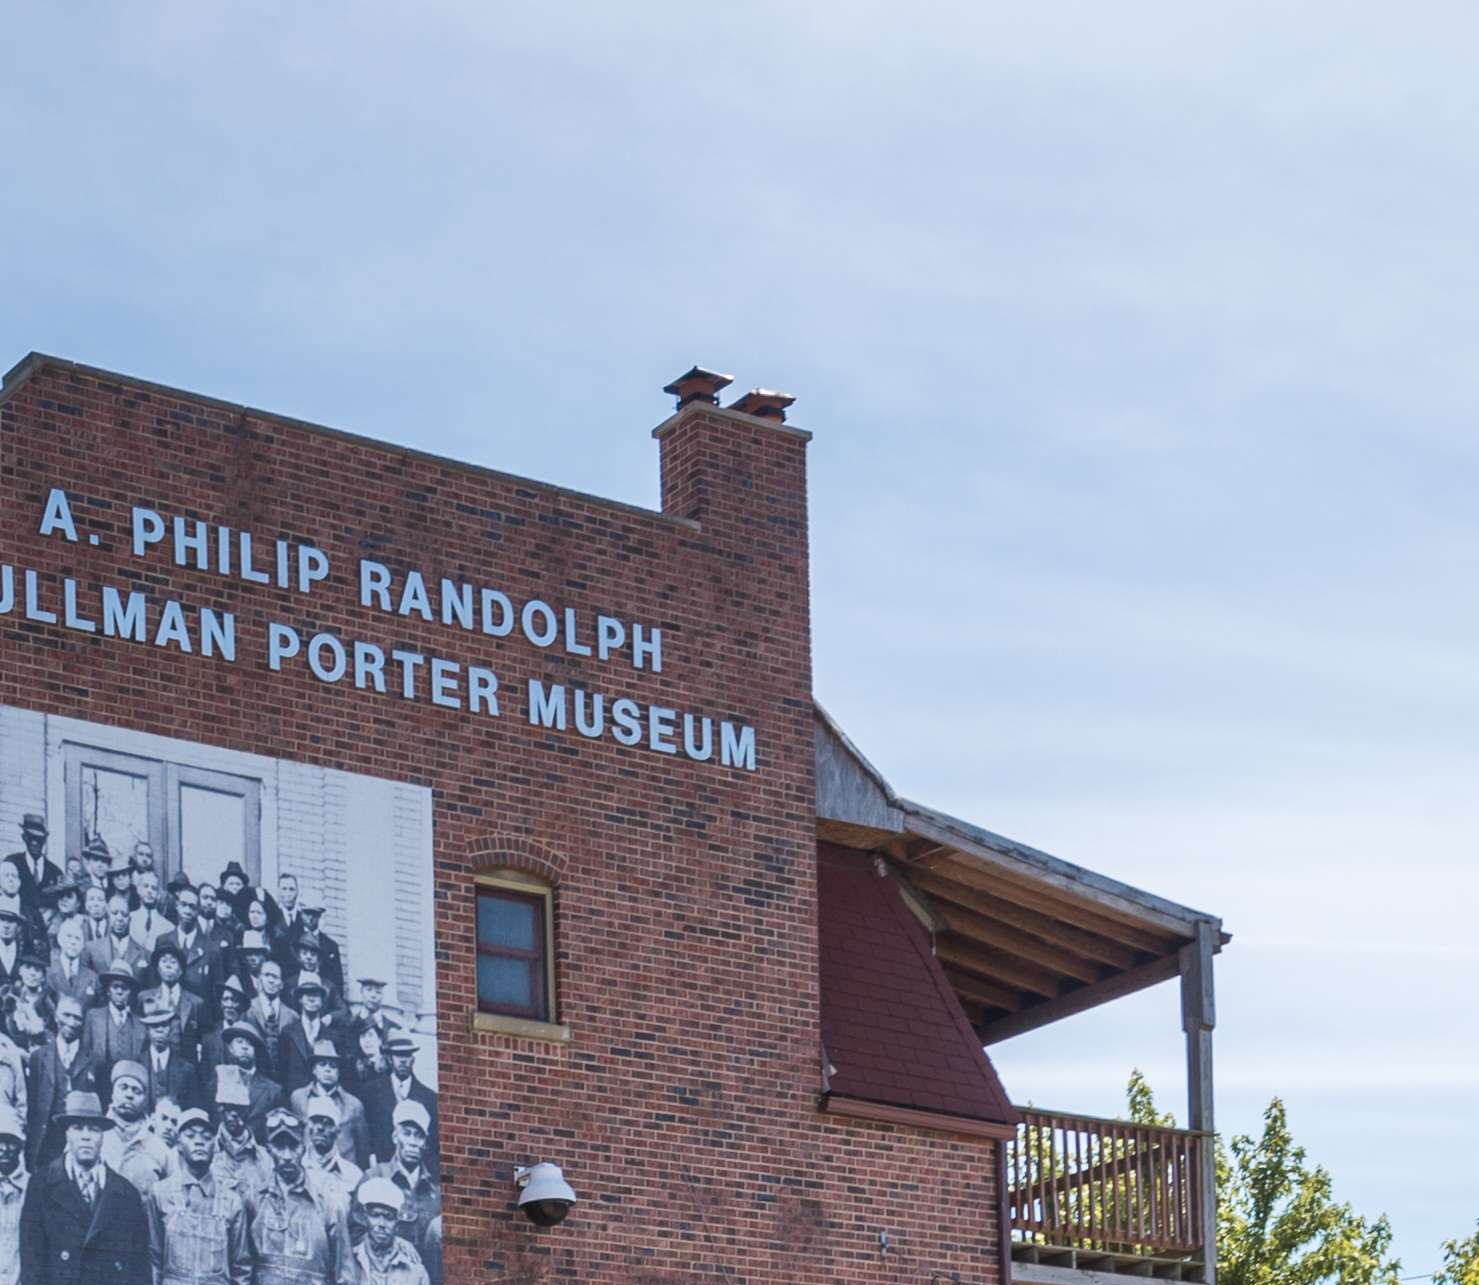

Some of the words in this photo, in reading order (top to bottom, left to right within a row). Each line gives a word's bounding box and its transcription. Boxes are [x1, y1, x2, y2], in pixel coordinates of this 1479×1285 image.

[39, 488, 100, 546] A.
[132, 506, 330, 594] PHILIP
[360, 559, 663, 673] RANDOLPH
[269, 622, 500, 718] PORTER
[528, 678, 758, 772] MUSEUM
